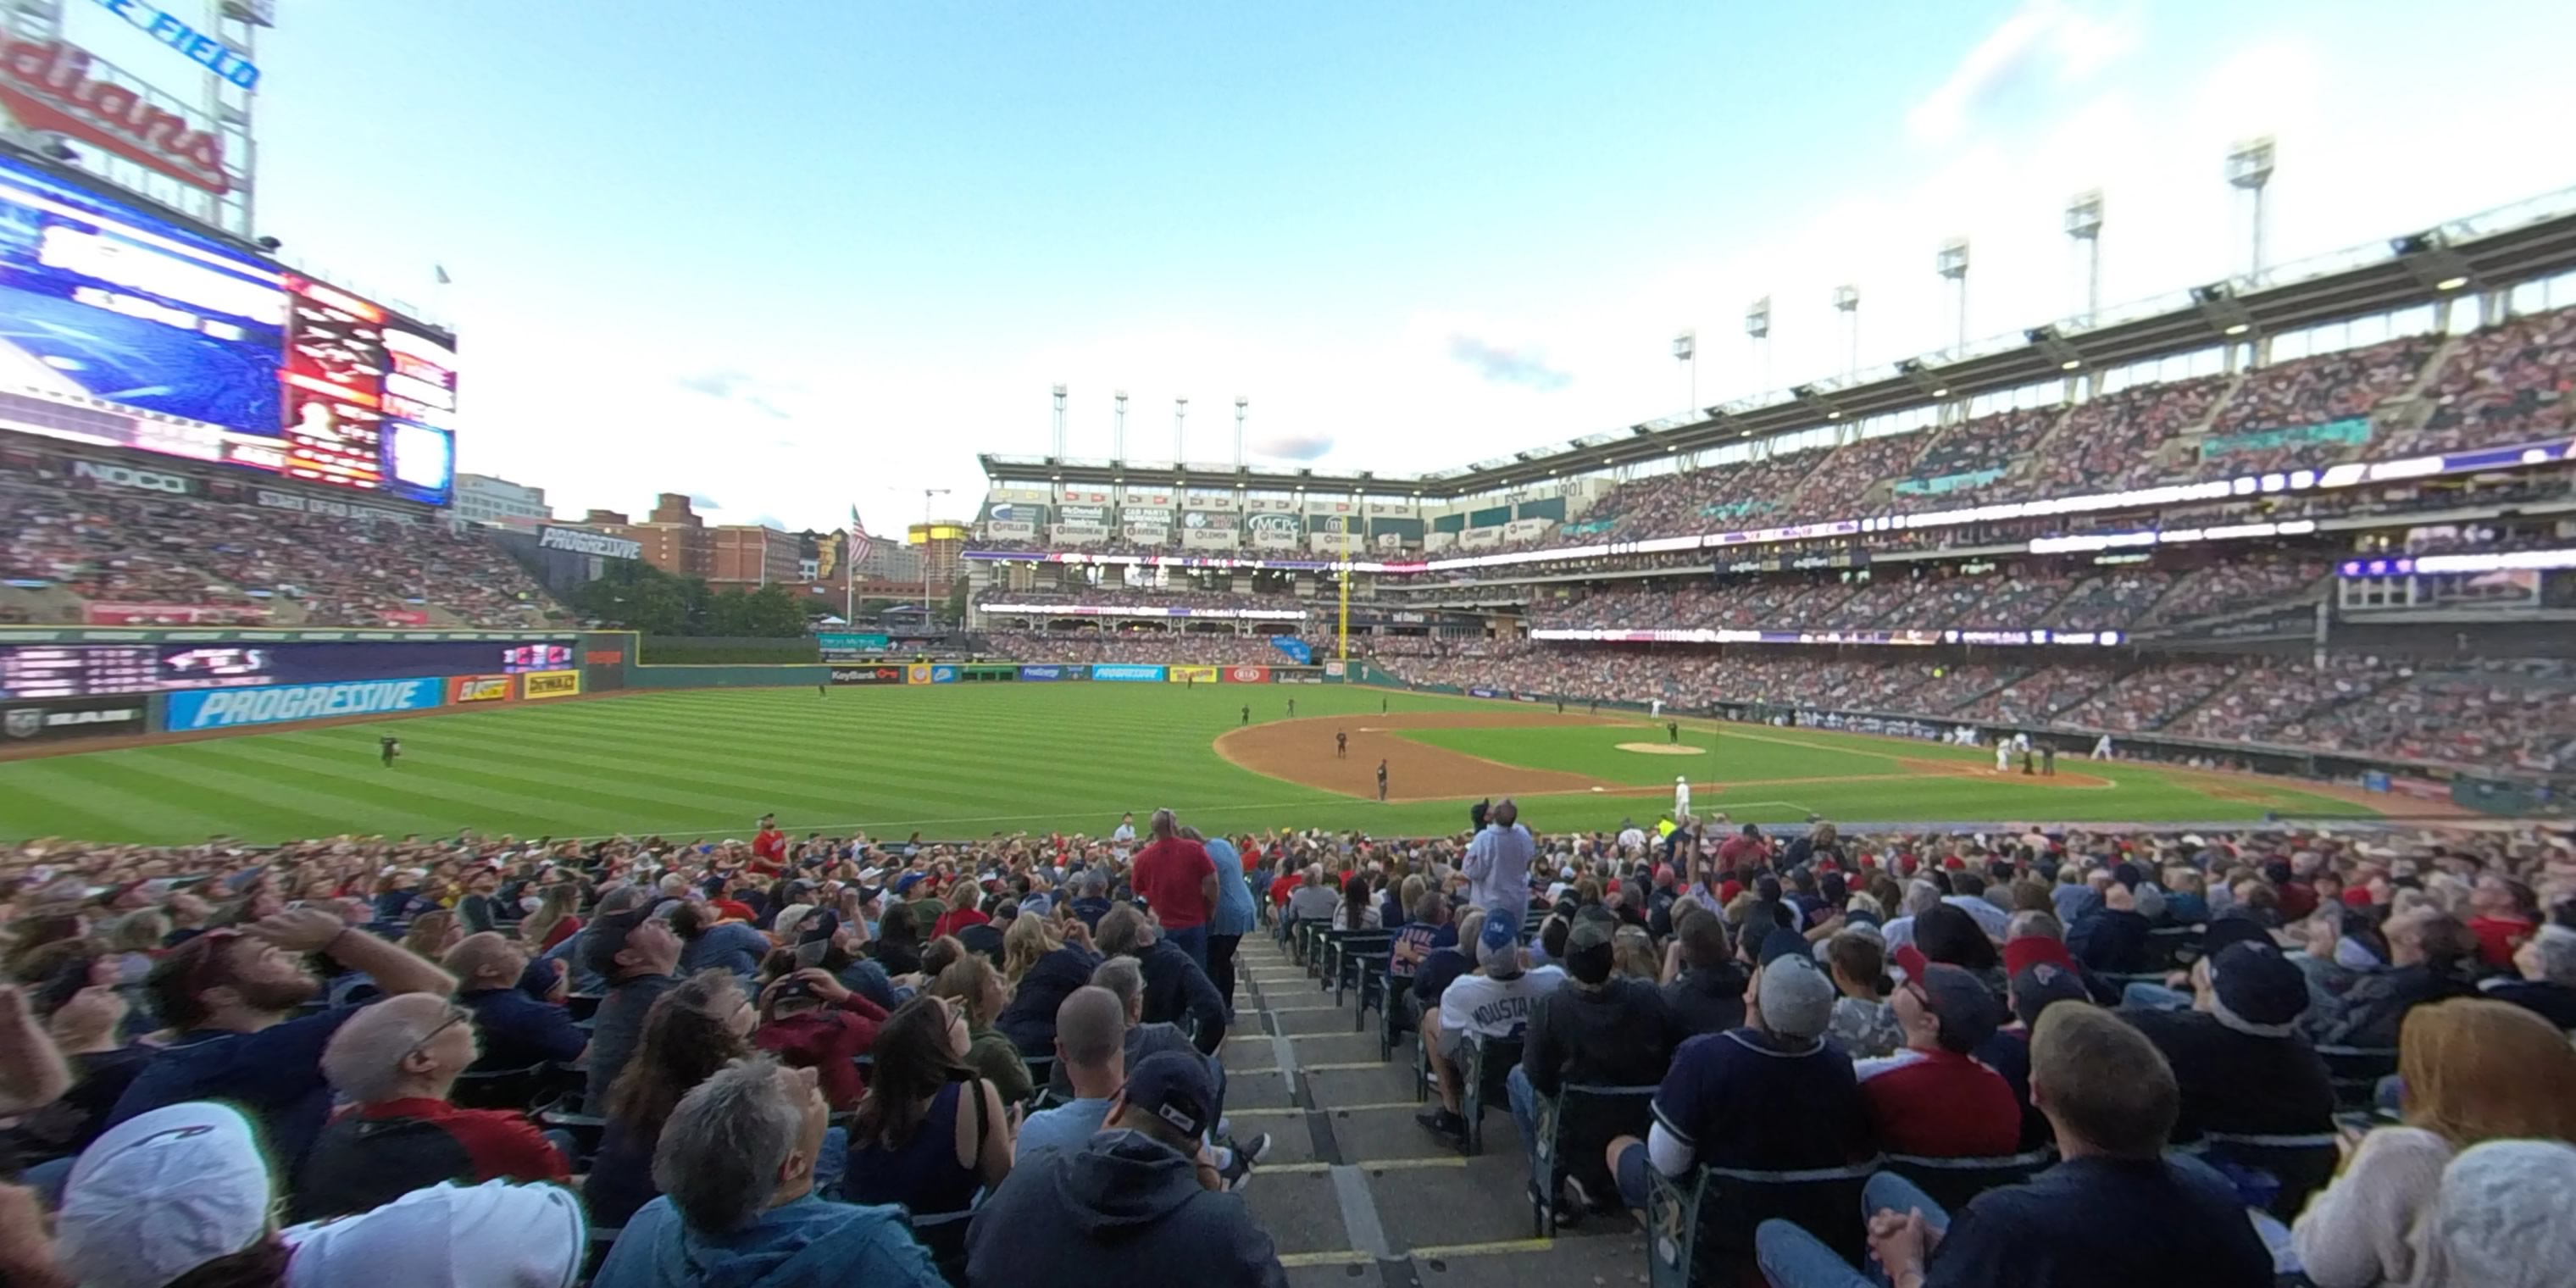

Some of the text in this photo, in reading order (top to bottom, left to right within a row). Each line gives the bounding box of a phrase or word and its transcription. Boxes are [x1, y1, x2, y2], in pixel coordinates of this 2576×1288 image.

[75, 462, 186, 493] NOCO
[1554, 480, 1584, 498] 1901
[1124, 508, 1141, 516] CAR
[539, 527, 642, 560] PROGRESSIVE
[831, 669, 877, 682] KeyBank
[192, 680, 422, 728] PROGRESSIVE
